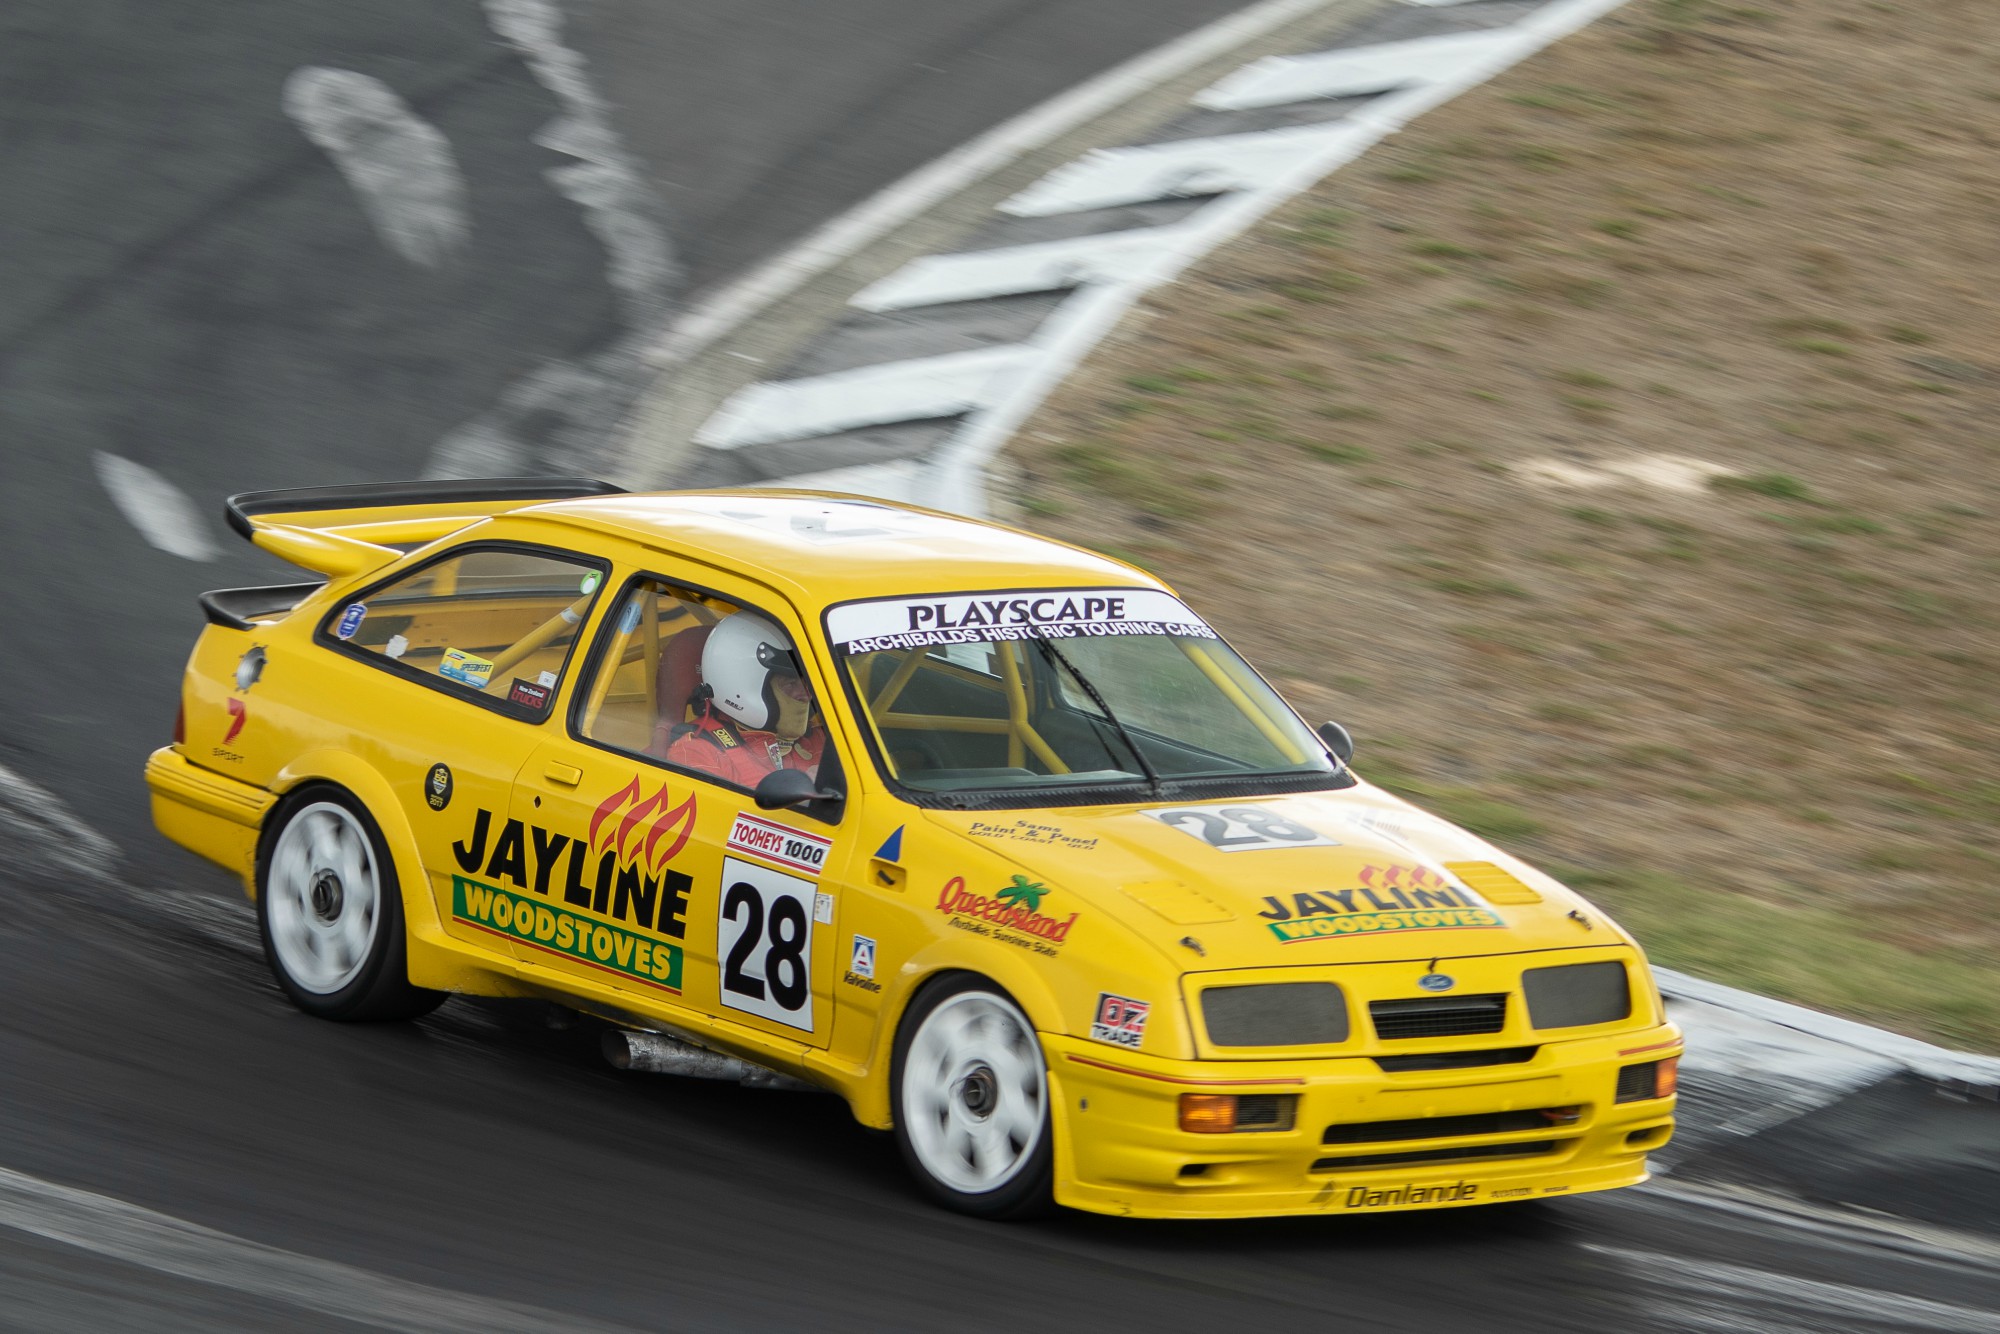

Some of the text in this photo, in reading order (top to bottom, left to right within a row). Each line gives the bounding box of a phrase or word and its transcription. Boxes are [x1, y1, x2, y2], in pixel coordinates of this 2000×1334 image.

[907, 597, 1125, 631] PLAYSCAPE
[849, 629, 980, 655] ARCHIBALDS
[1076, 622, 1163, 637] TOURING
[1166, 622, 1217, 640] CARS
[222, 697, 247, 746] 7
[715, 729, 735, 747] OMP
[733, 822, 824, 865] TOOHEYS 1000
[970, 822, 1016, 834] Paint
[1049, 833, 1099, 846] Panel
[1158, 808, 1320, 847] 28
[452, 808, 694, 940] JAYLINE
[463, 882, 671, 981] WOODSTOVES
[1276, 911, 1497, 939] WOODSTOVES
[722, 882, 808, 1012] 28
[843, 970, 882, 994] Valvoline
[1345, 1180, 1478, 1208] Danlande
